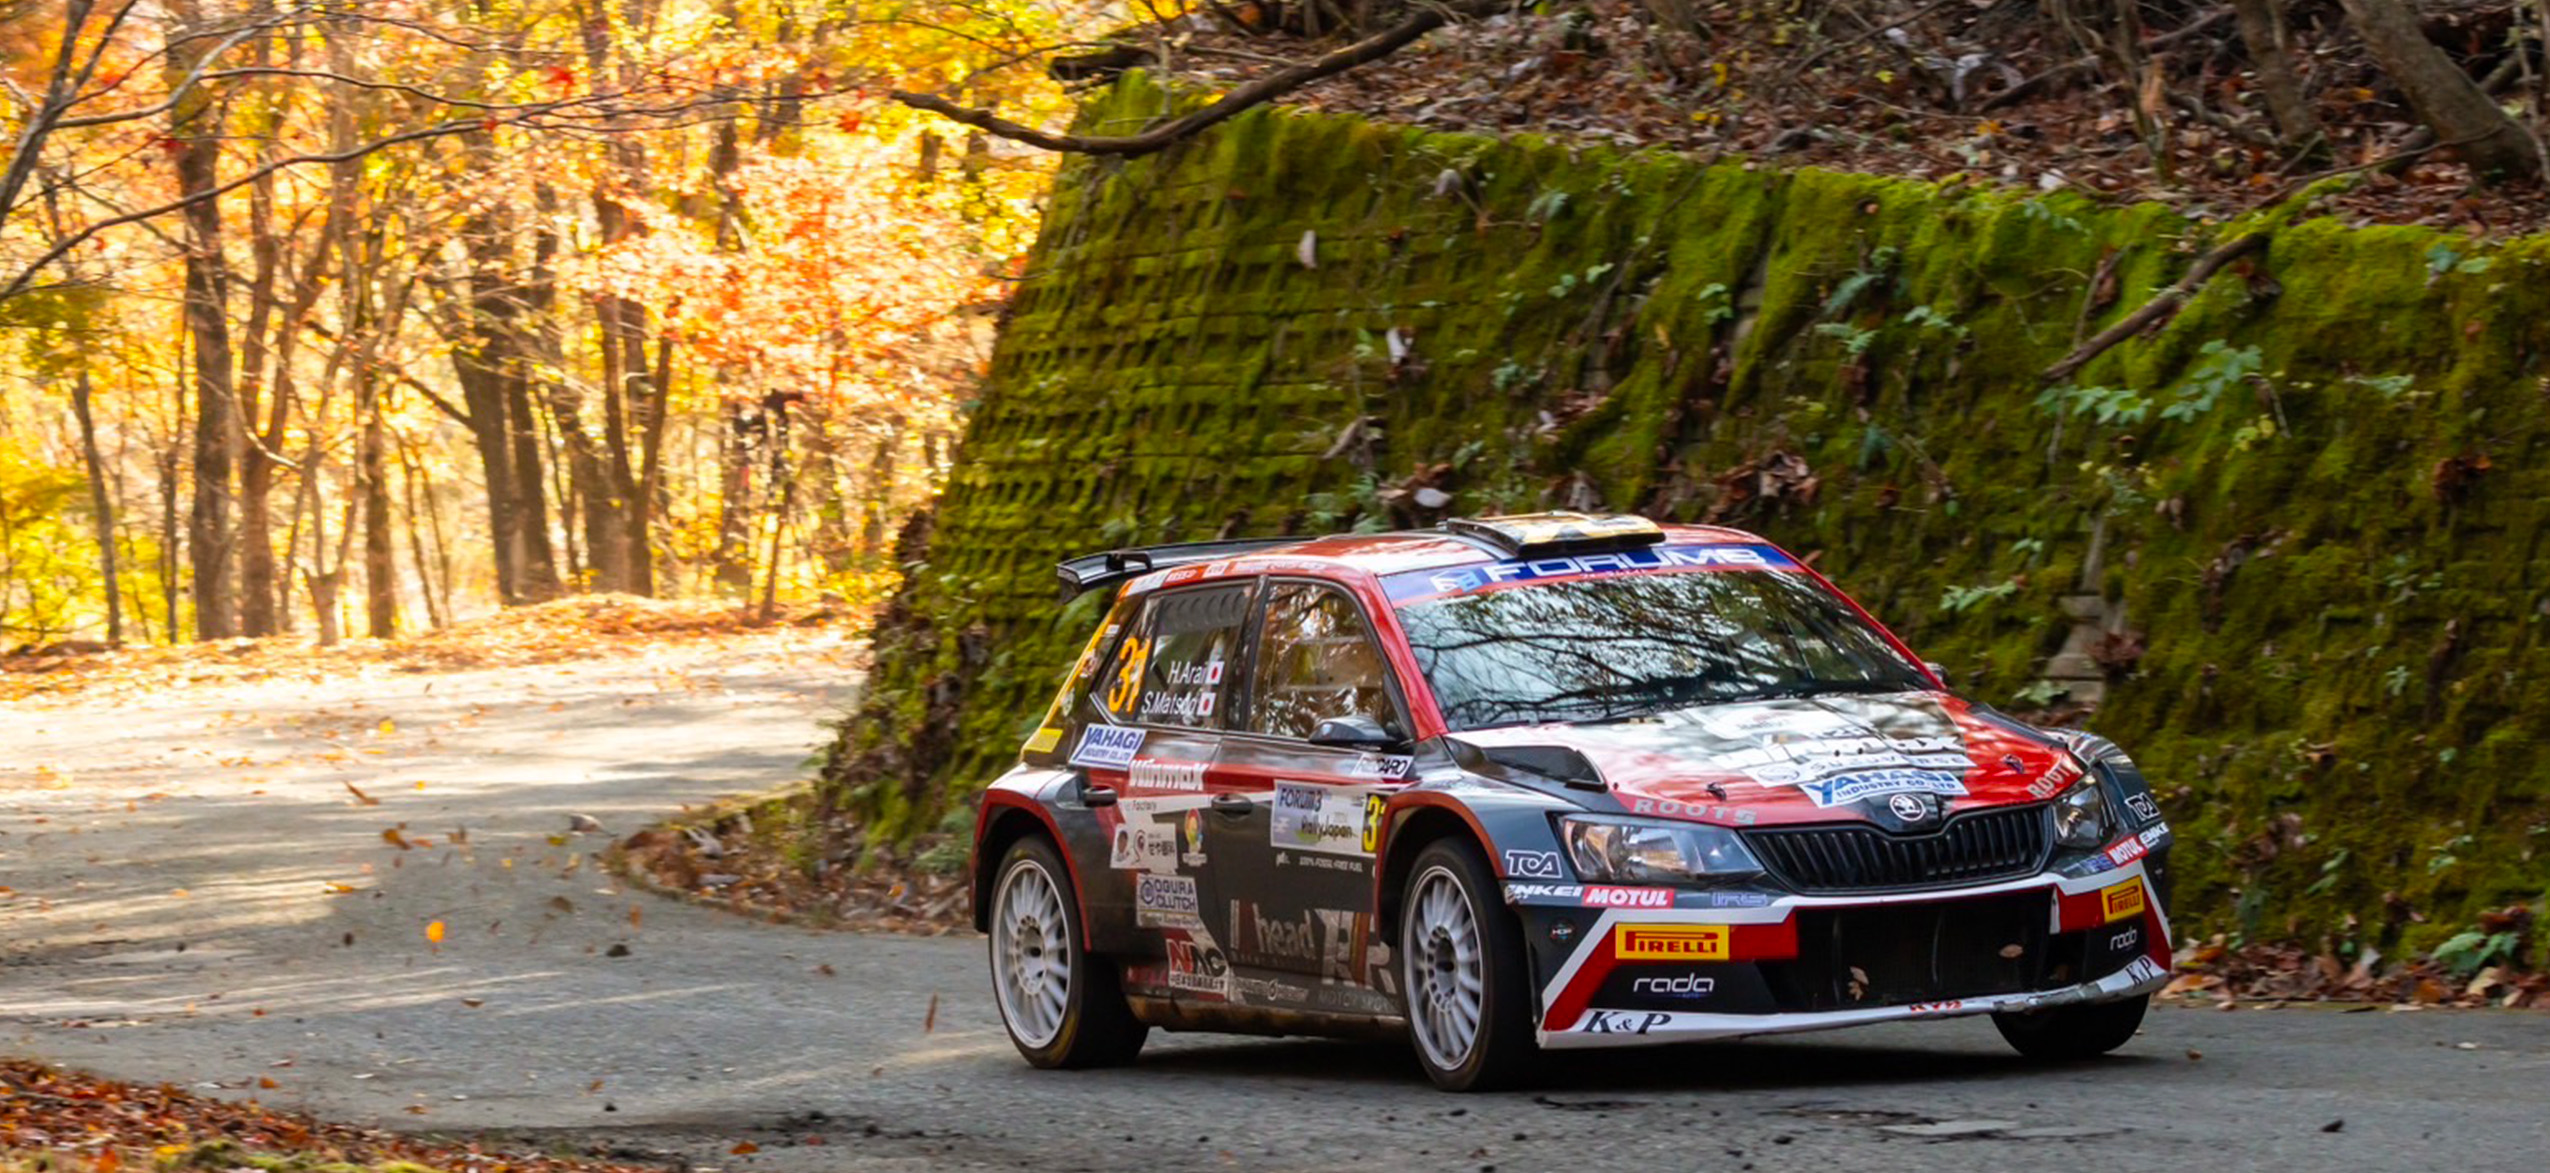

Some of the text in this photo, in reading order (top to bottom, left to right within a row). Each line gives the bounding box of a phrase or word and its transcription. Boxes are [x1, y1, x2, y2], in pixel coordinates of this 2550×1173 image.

[1108, 637, 1151, 712] 31
[1073, 727, 1144, 760] YAHAGI
[1805, 769, 1957, 806] YAHAGI
[1632, 799, 1757, 825] ROOTS
[1154, 879, 1195, 895] OGURA
[1585, 888, 1668, 906] MOTUL
[1155, 894, 1197, 911] CLUTCH
[1625, 931, 1719, 953] PIRELLI
[1632, 972, 1715, 993] rada
[1582, 1010, 1673, 1035] K&P
